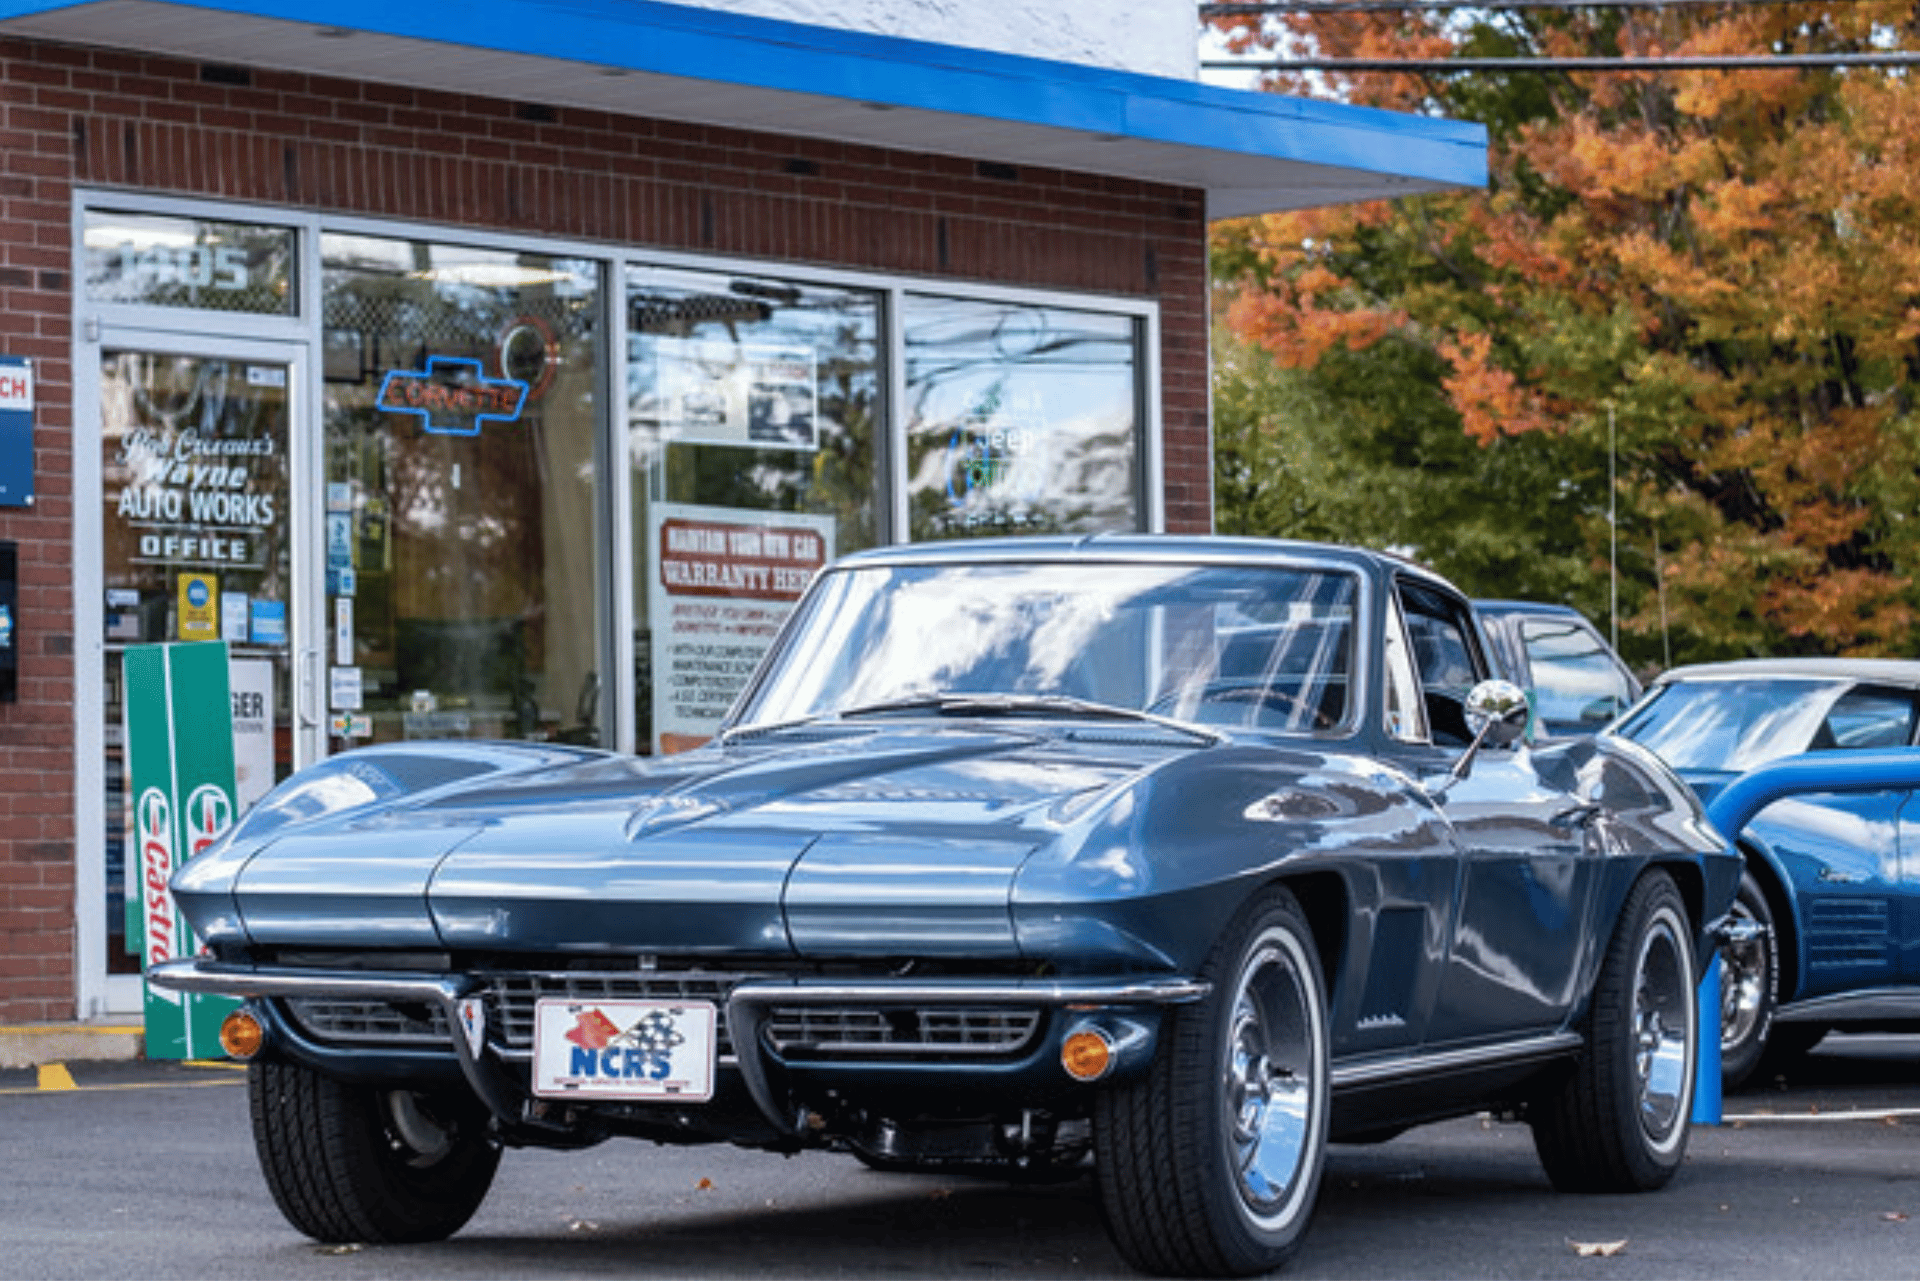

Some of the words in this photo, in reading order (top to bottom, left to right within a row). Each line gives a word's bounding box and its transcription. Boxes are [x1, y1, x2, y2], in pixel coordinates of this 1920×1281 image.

[120, 241, 249, 290] 1405
[386, 378, 518, 411] CORVETTE
[118, 487, 182, 520] AUTO
[190, 491, 275, 525] WORKS
[140, 535, 247, 560] OFFICE
[662, 560, 771, 590] WARRANTY
[772, 567, 811, 591] HER
[145, 840, 173, 964] Castro
[569, 1046, 673, 1080] NCRS
